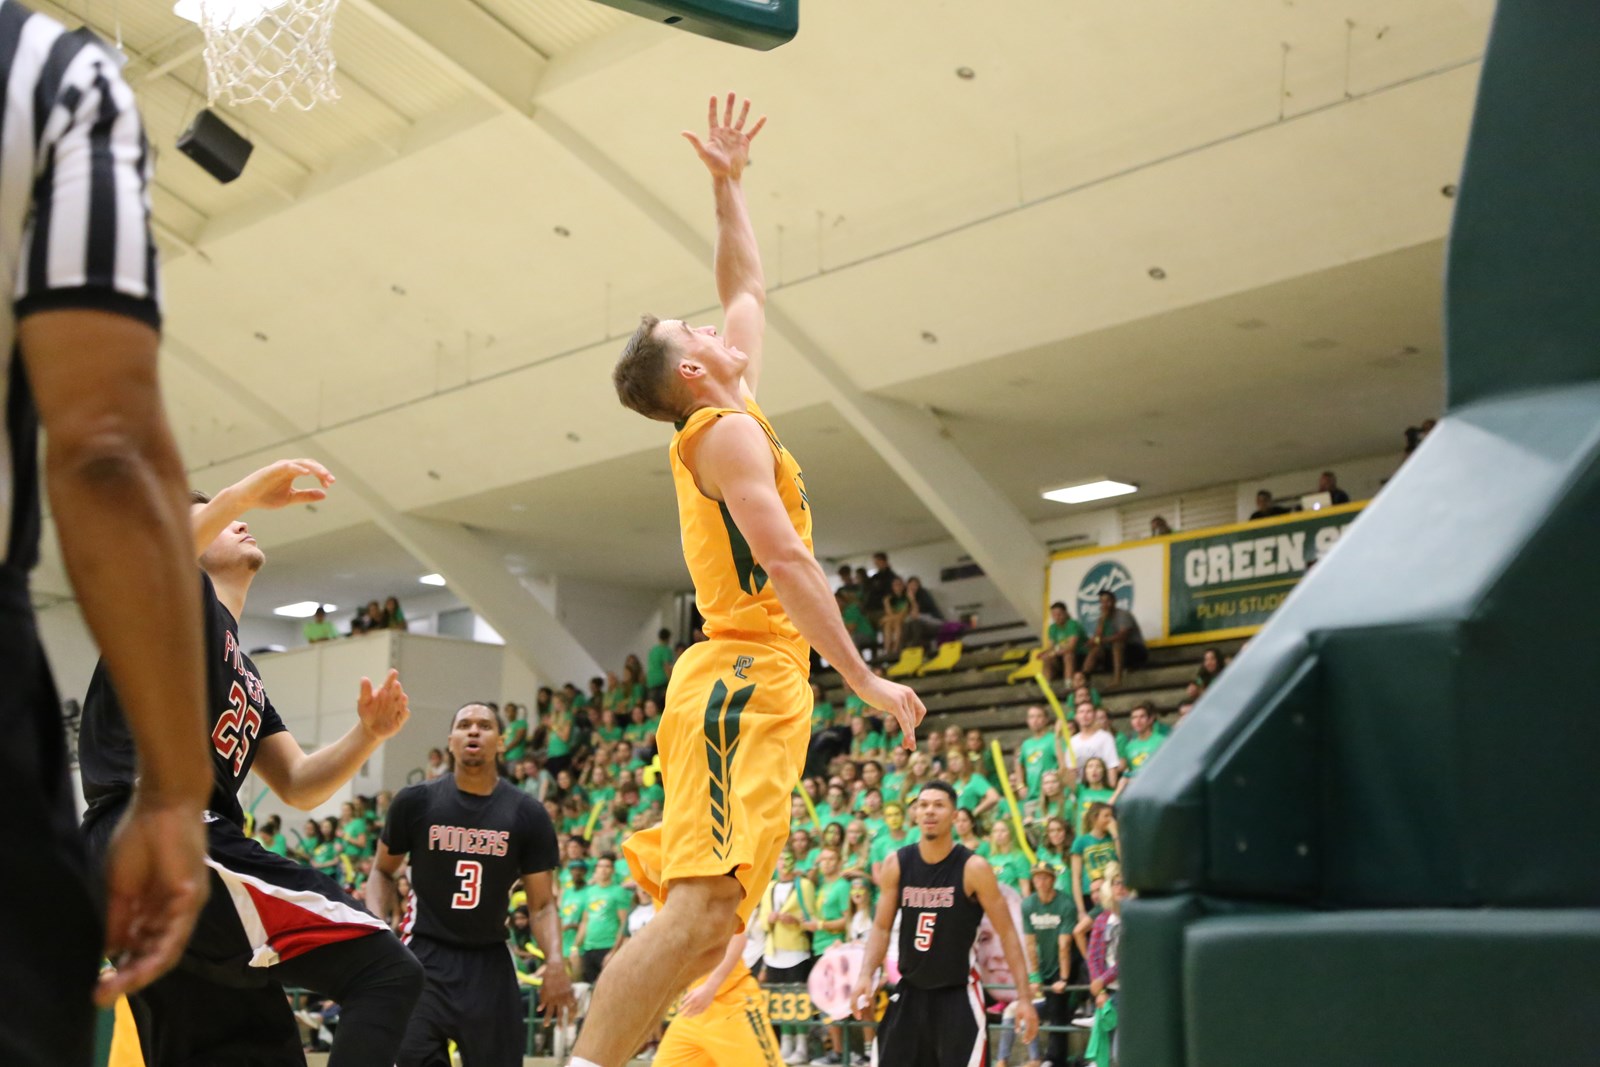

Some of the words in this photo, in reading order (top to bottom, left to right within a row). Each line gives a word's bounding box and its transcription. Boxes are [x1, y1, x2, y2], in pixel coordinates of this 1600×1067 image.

[1185, 531, 1306, 587] GREEN
[1315, 523, 1350, 560] S
[211, 680, 262, 777] 25
[428, 824, 510, 857] PIONEERS
[451, 860, 483, 909] 3
[902, 886, 955, 909] PIONEERS
[914, 912, 938, 952] 5
